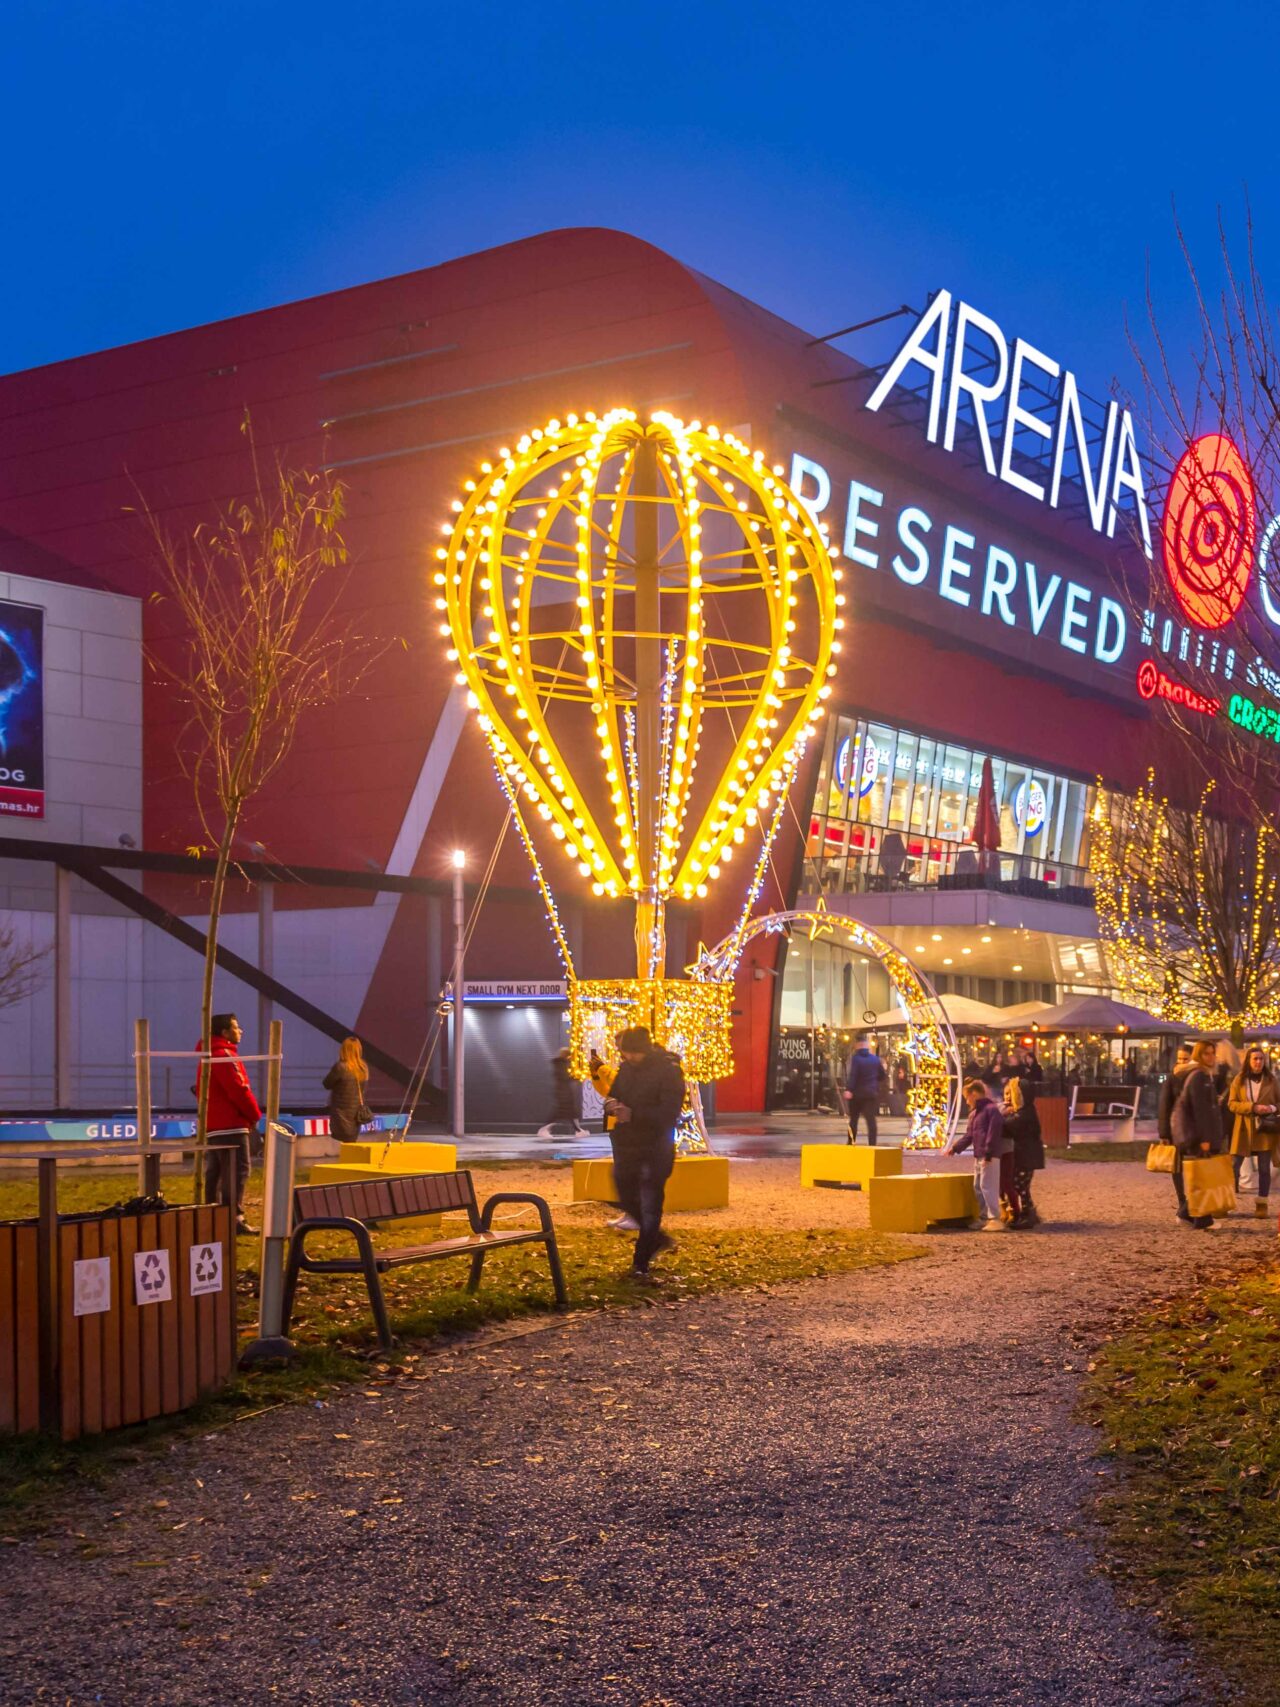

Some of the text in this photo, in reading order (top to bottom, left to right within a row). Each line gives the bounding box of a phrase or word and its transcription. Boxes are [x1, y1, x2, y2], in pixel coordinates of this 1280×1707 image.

[865, 288, 1153, 560] ARENA
[787, 453, 1126, 664] RESERVED
[0, 767, 25, 782] OG
[467, 984, 560, 995] SMALL GYM NEXT DOOR
[782, 1049, 810, 1060] ROOM
[86, 1123, 157, 1139] GLEDJ
